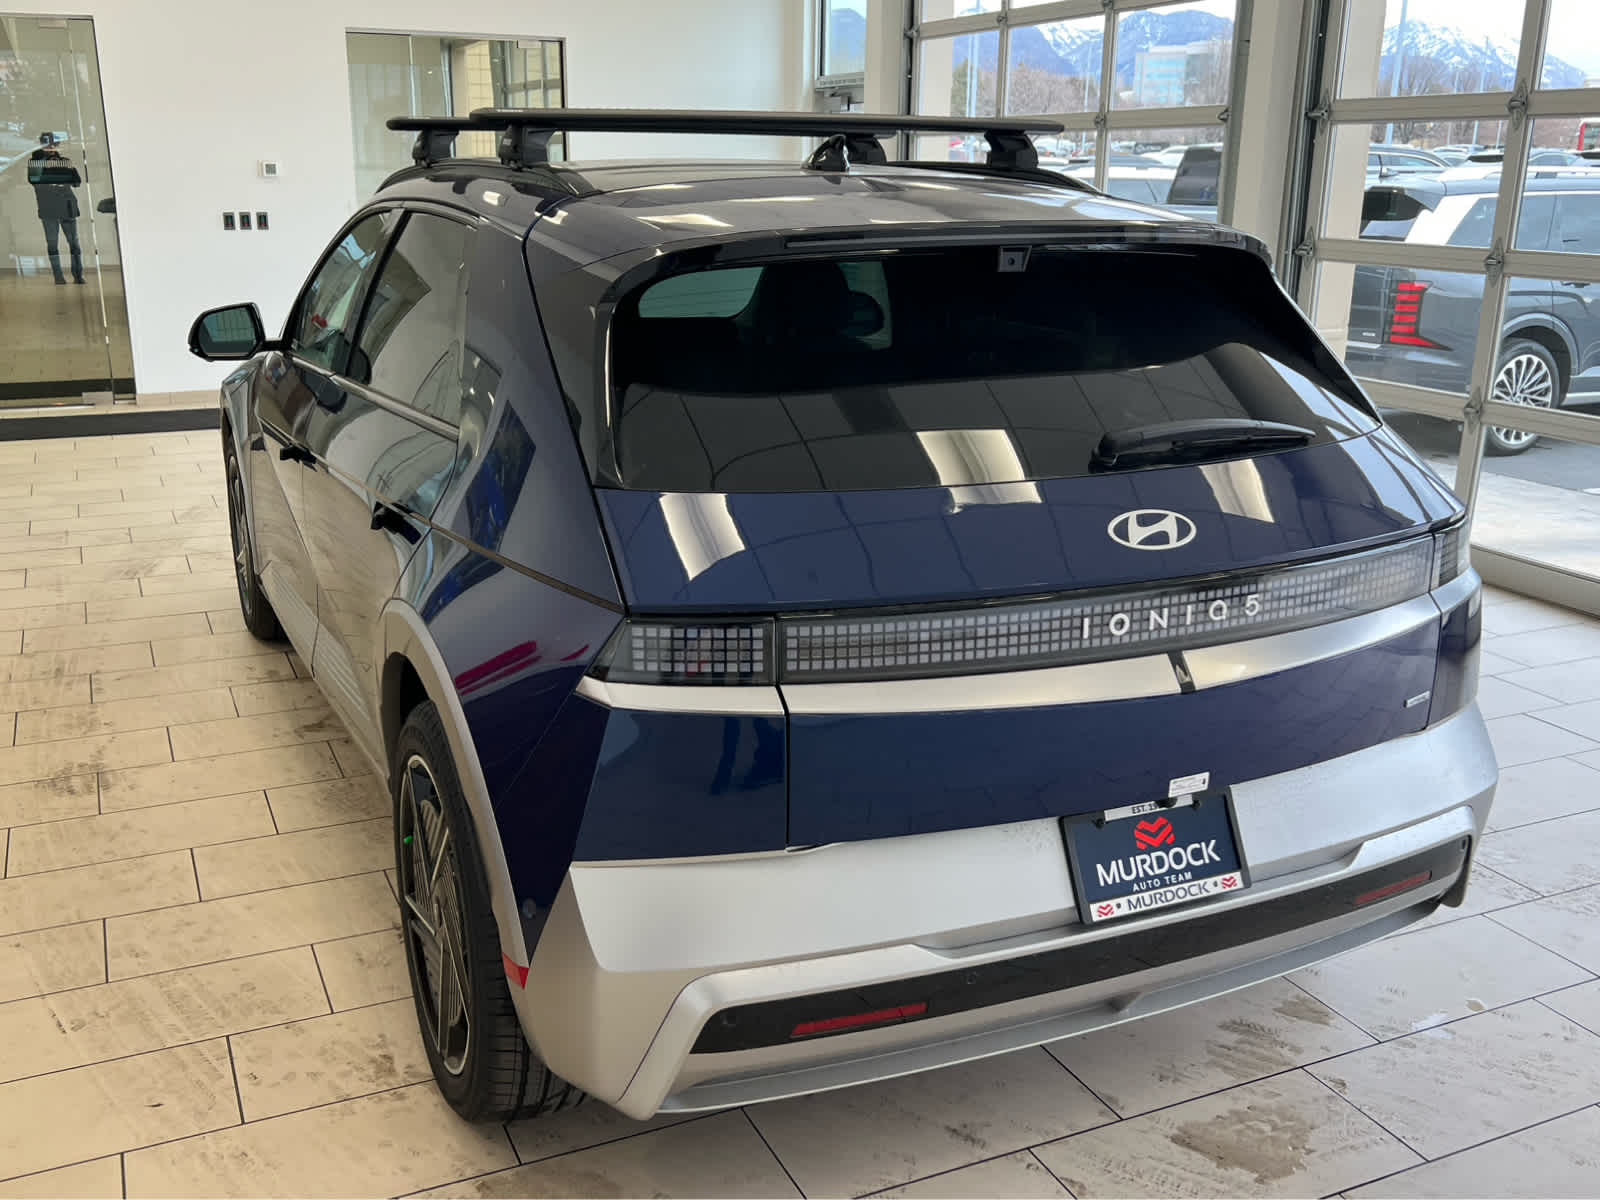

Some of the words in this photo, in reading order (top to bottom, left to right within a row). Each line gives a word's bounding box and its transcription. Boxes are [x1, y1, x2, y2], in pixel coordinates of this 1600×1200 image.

[1083, 600, 1227, 639] IONIQ
[1245, 594, 1260, 616] 5
[1096, 839, 1221, 887] MURDOCK
[1133, 879, 1161, 892] AUTO
[1165, 871, 1193, 885] TEAM
[1127, 881, 1210, 911] MURDOCK
